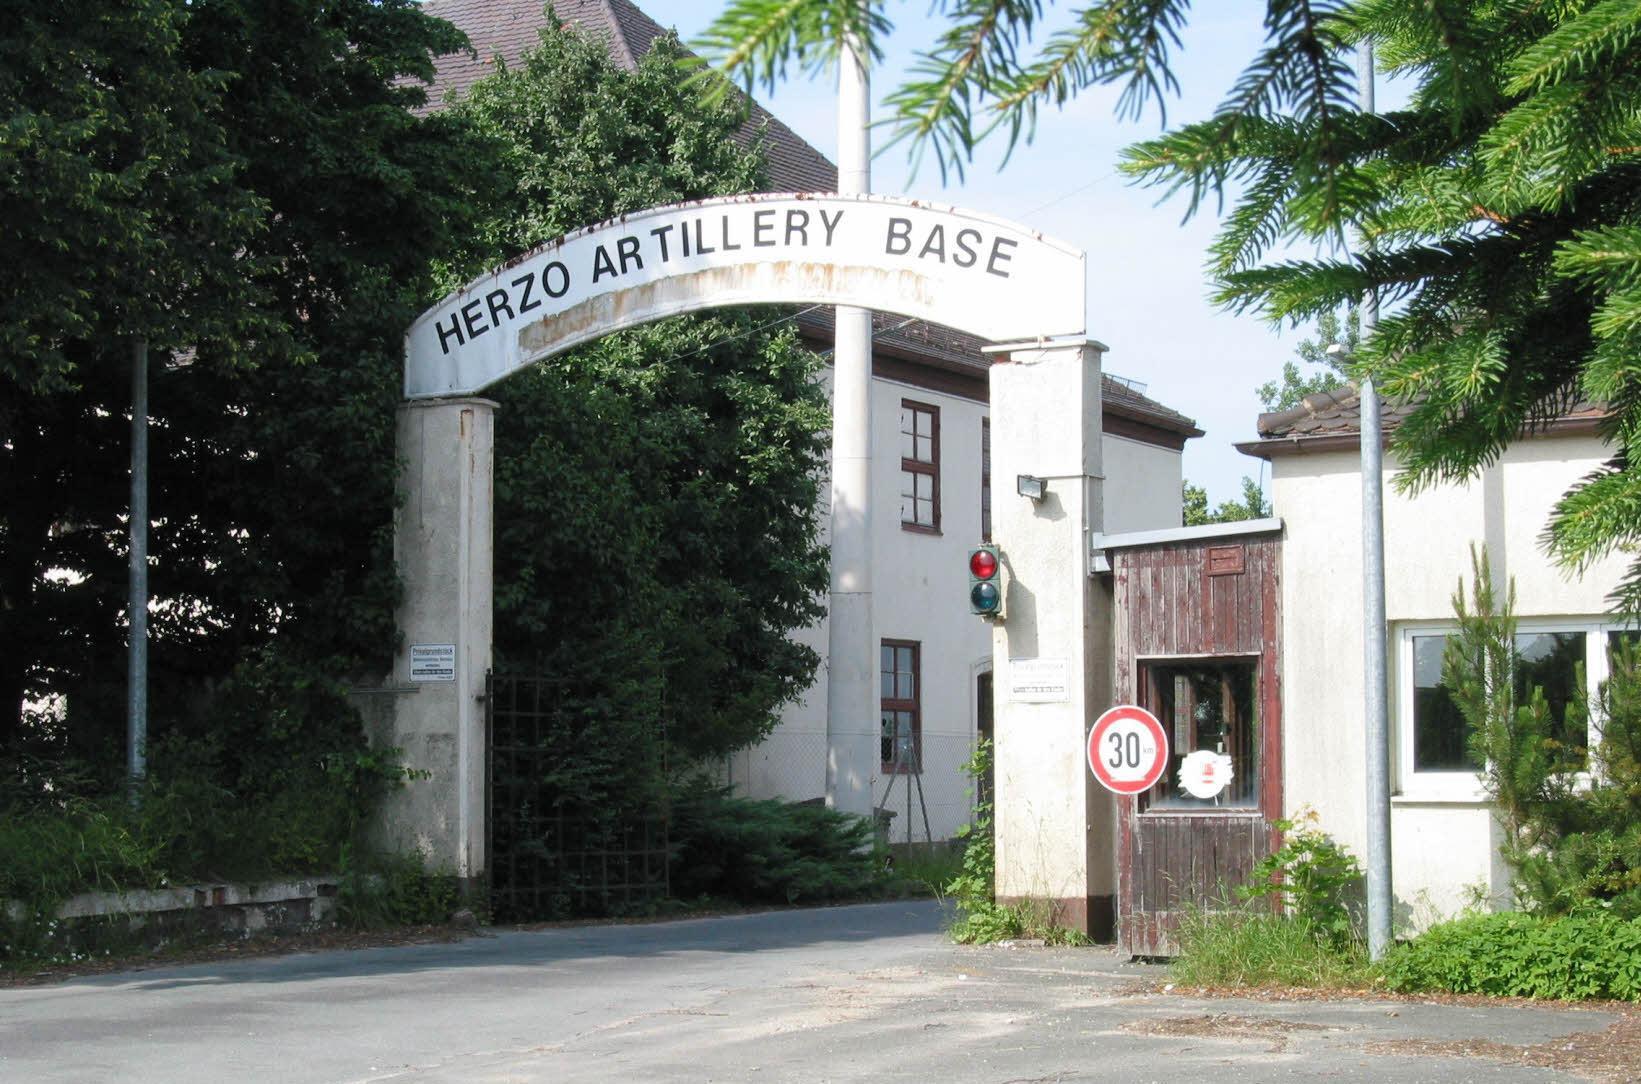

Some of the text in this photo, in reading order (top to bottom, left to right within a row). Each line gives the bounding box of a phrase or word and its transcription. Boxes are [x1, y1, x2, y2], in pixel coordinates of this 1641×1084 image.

[435, 209, 1018, 355] HERZO ARTILLERY BASE
[1108, 731, 1140, 769] 30
